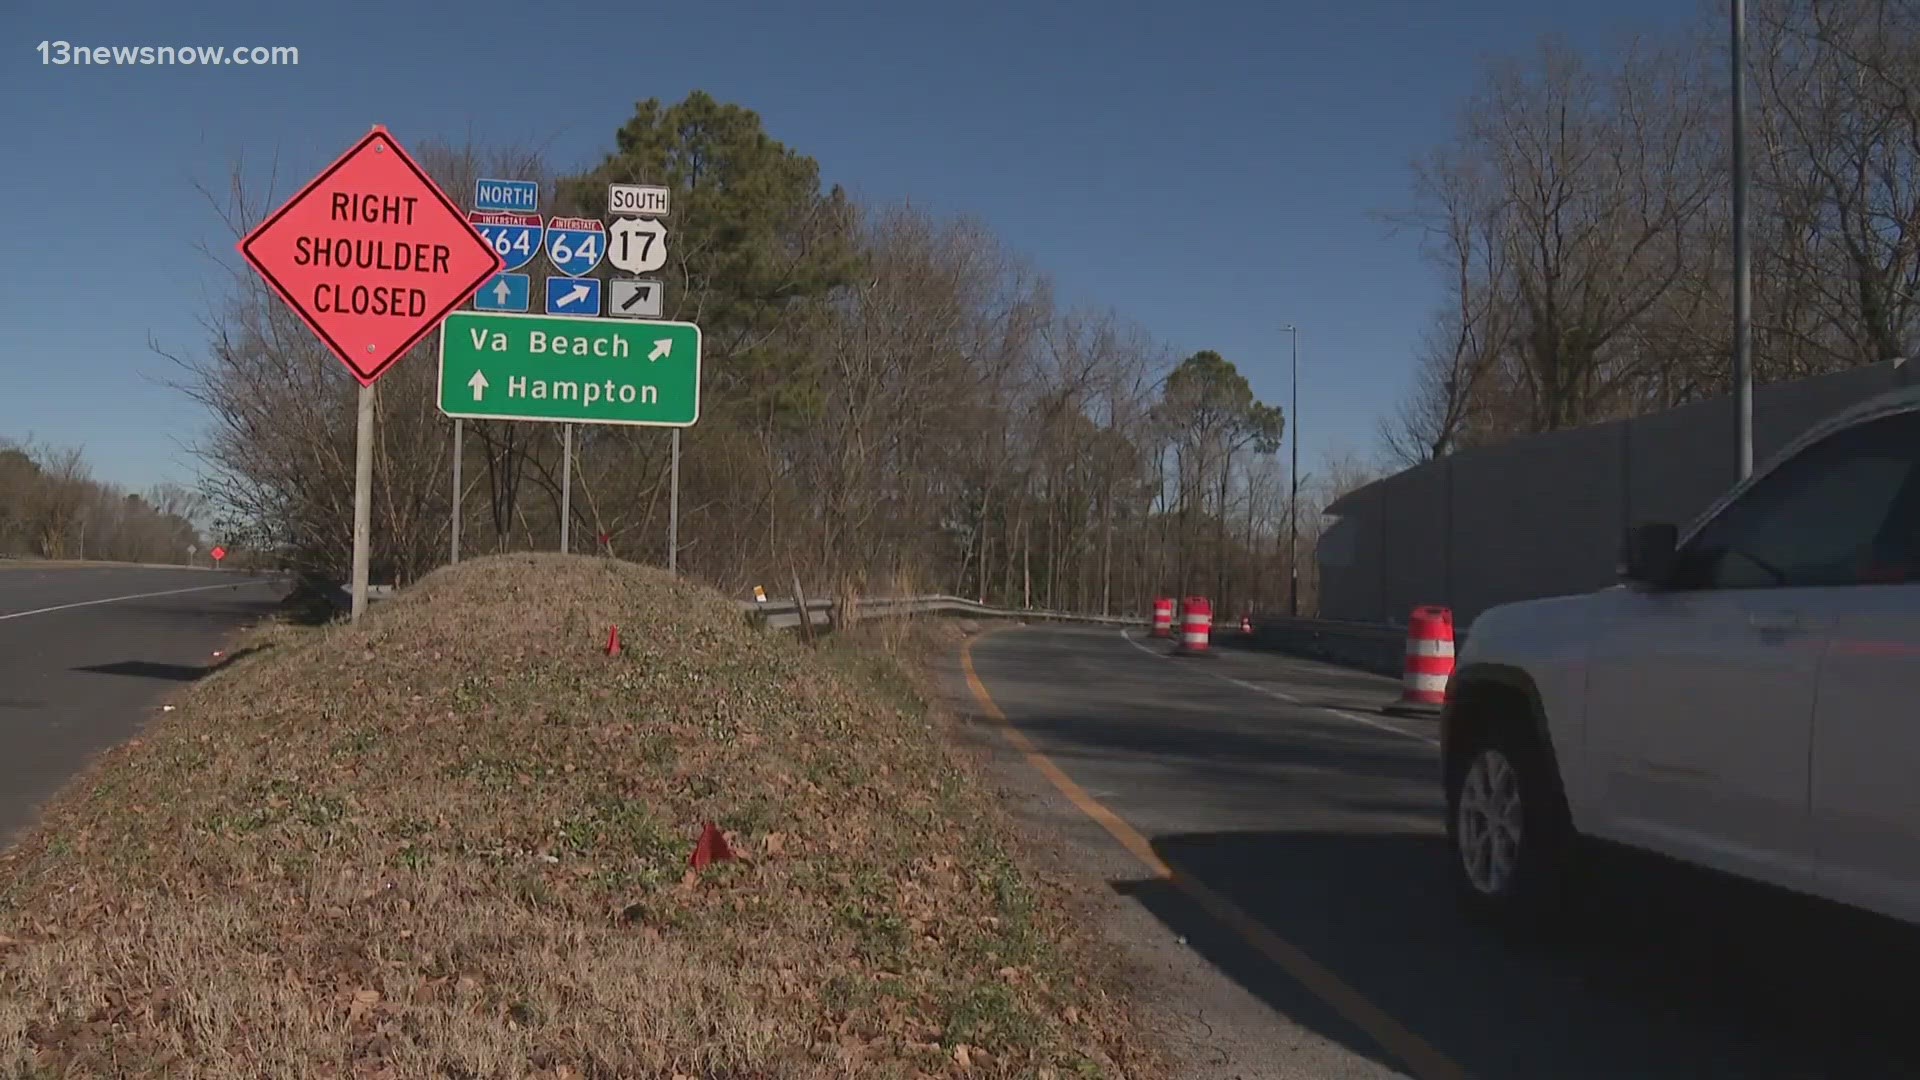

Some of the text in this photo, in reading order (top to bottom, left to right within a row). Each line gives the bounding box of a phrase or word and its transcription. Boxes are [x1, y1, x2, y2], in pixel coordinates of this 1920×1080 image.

[331, 192, 418, 225] RIGHT
[480, 185, 533, 205] NORTH
[613, 190, 666, 210] SOUTH
[482, 216, 527, 225] INTERSTATE
[555, 220, 596, 230] INTERSTATE
[294, 236, 450, 274] SHOULDER
[551, 233, 598, 265] 64
[619, 230, 657, 262] 17
[313, 283, 426, 318] CLOSED
[470, 328, 629, 358] Va Beach
[508, 375, 658, 407] Hampton
